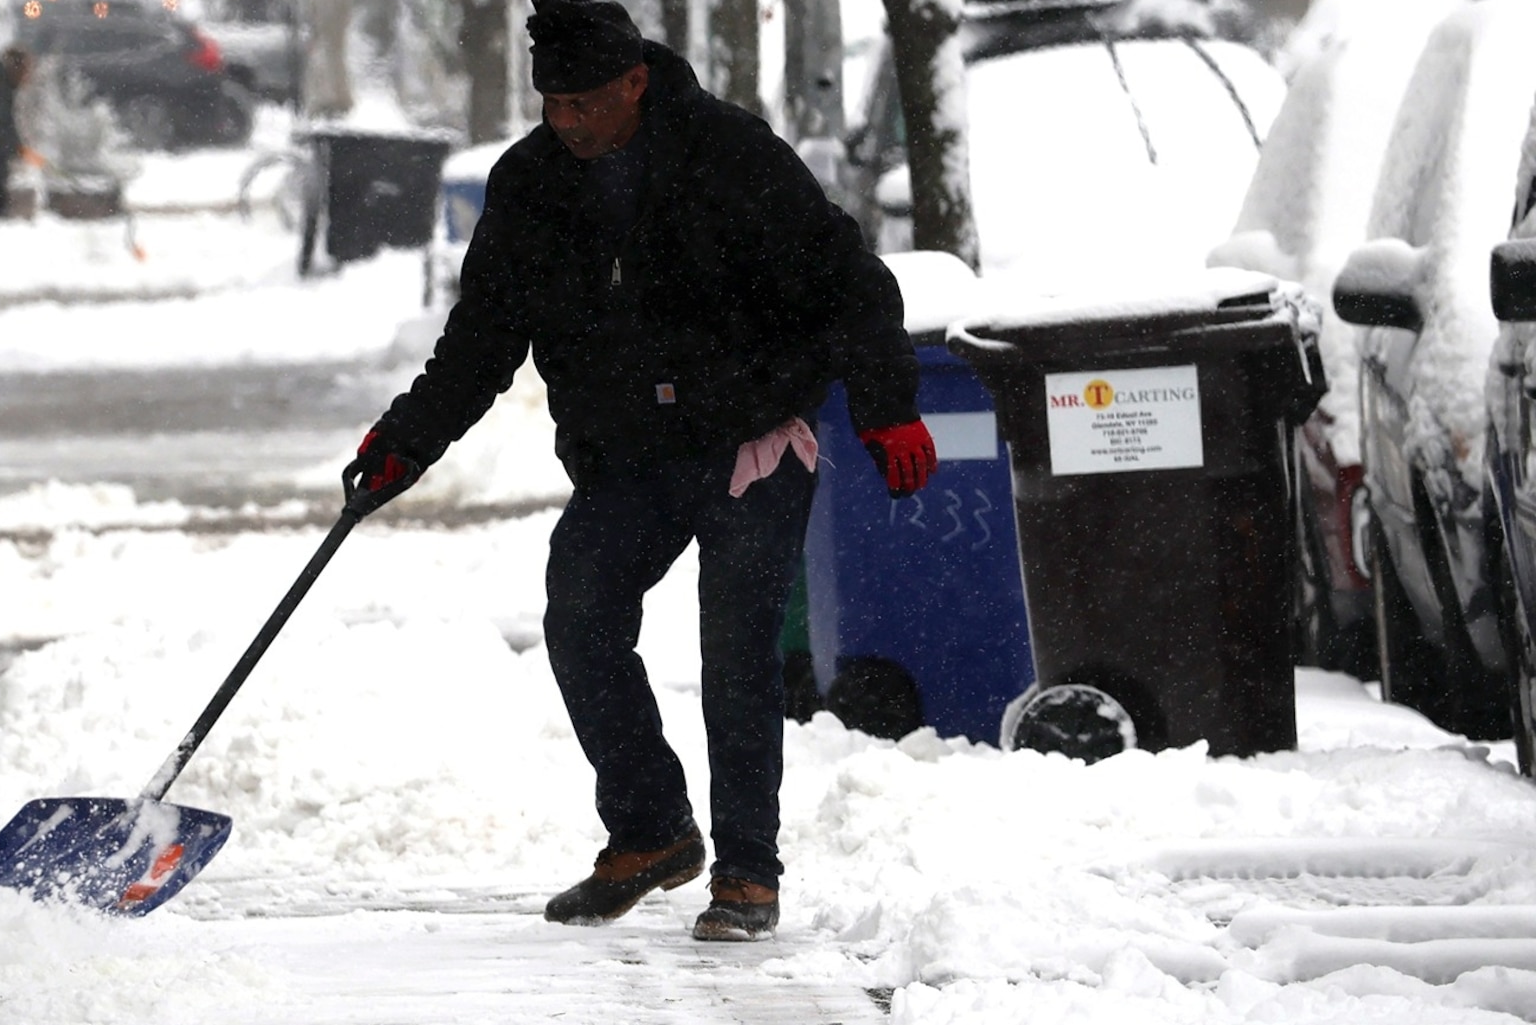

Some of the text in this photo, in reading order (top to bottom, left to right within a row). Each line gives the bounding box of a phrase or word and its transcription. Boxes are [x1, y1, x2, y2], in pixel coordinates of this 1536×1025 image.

[1050, 385, 1195, 409] MR. T CARTING
